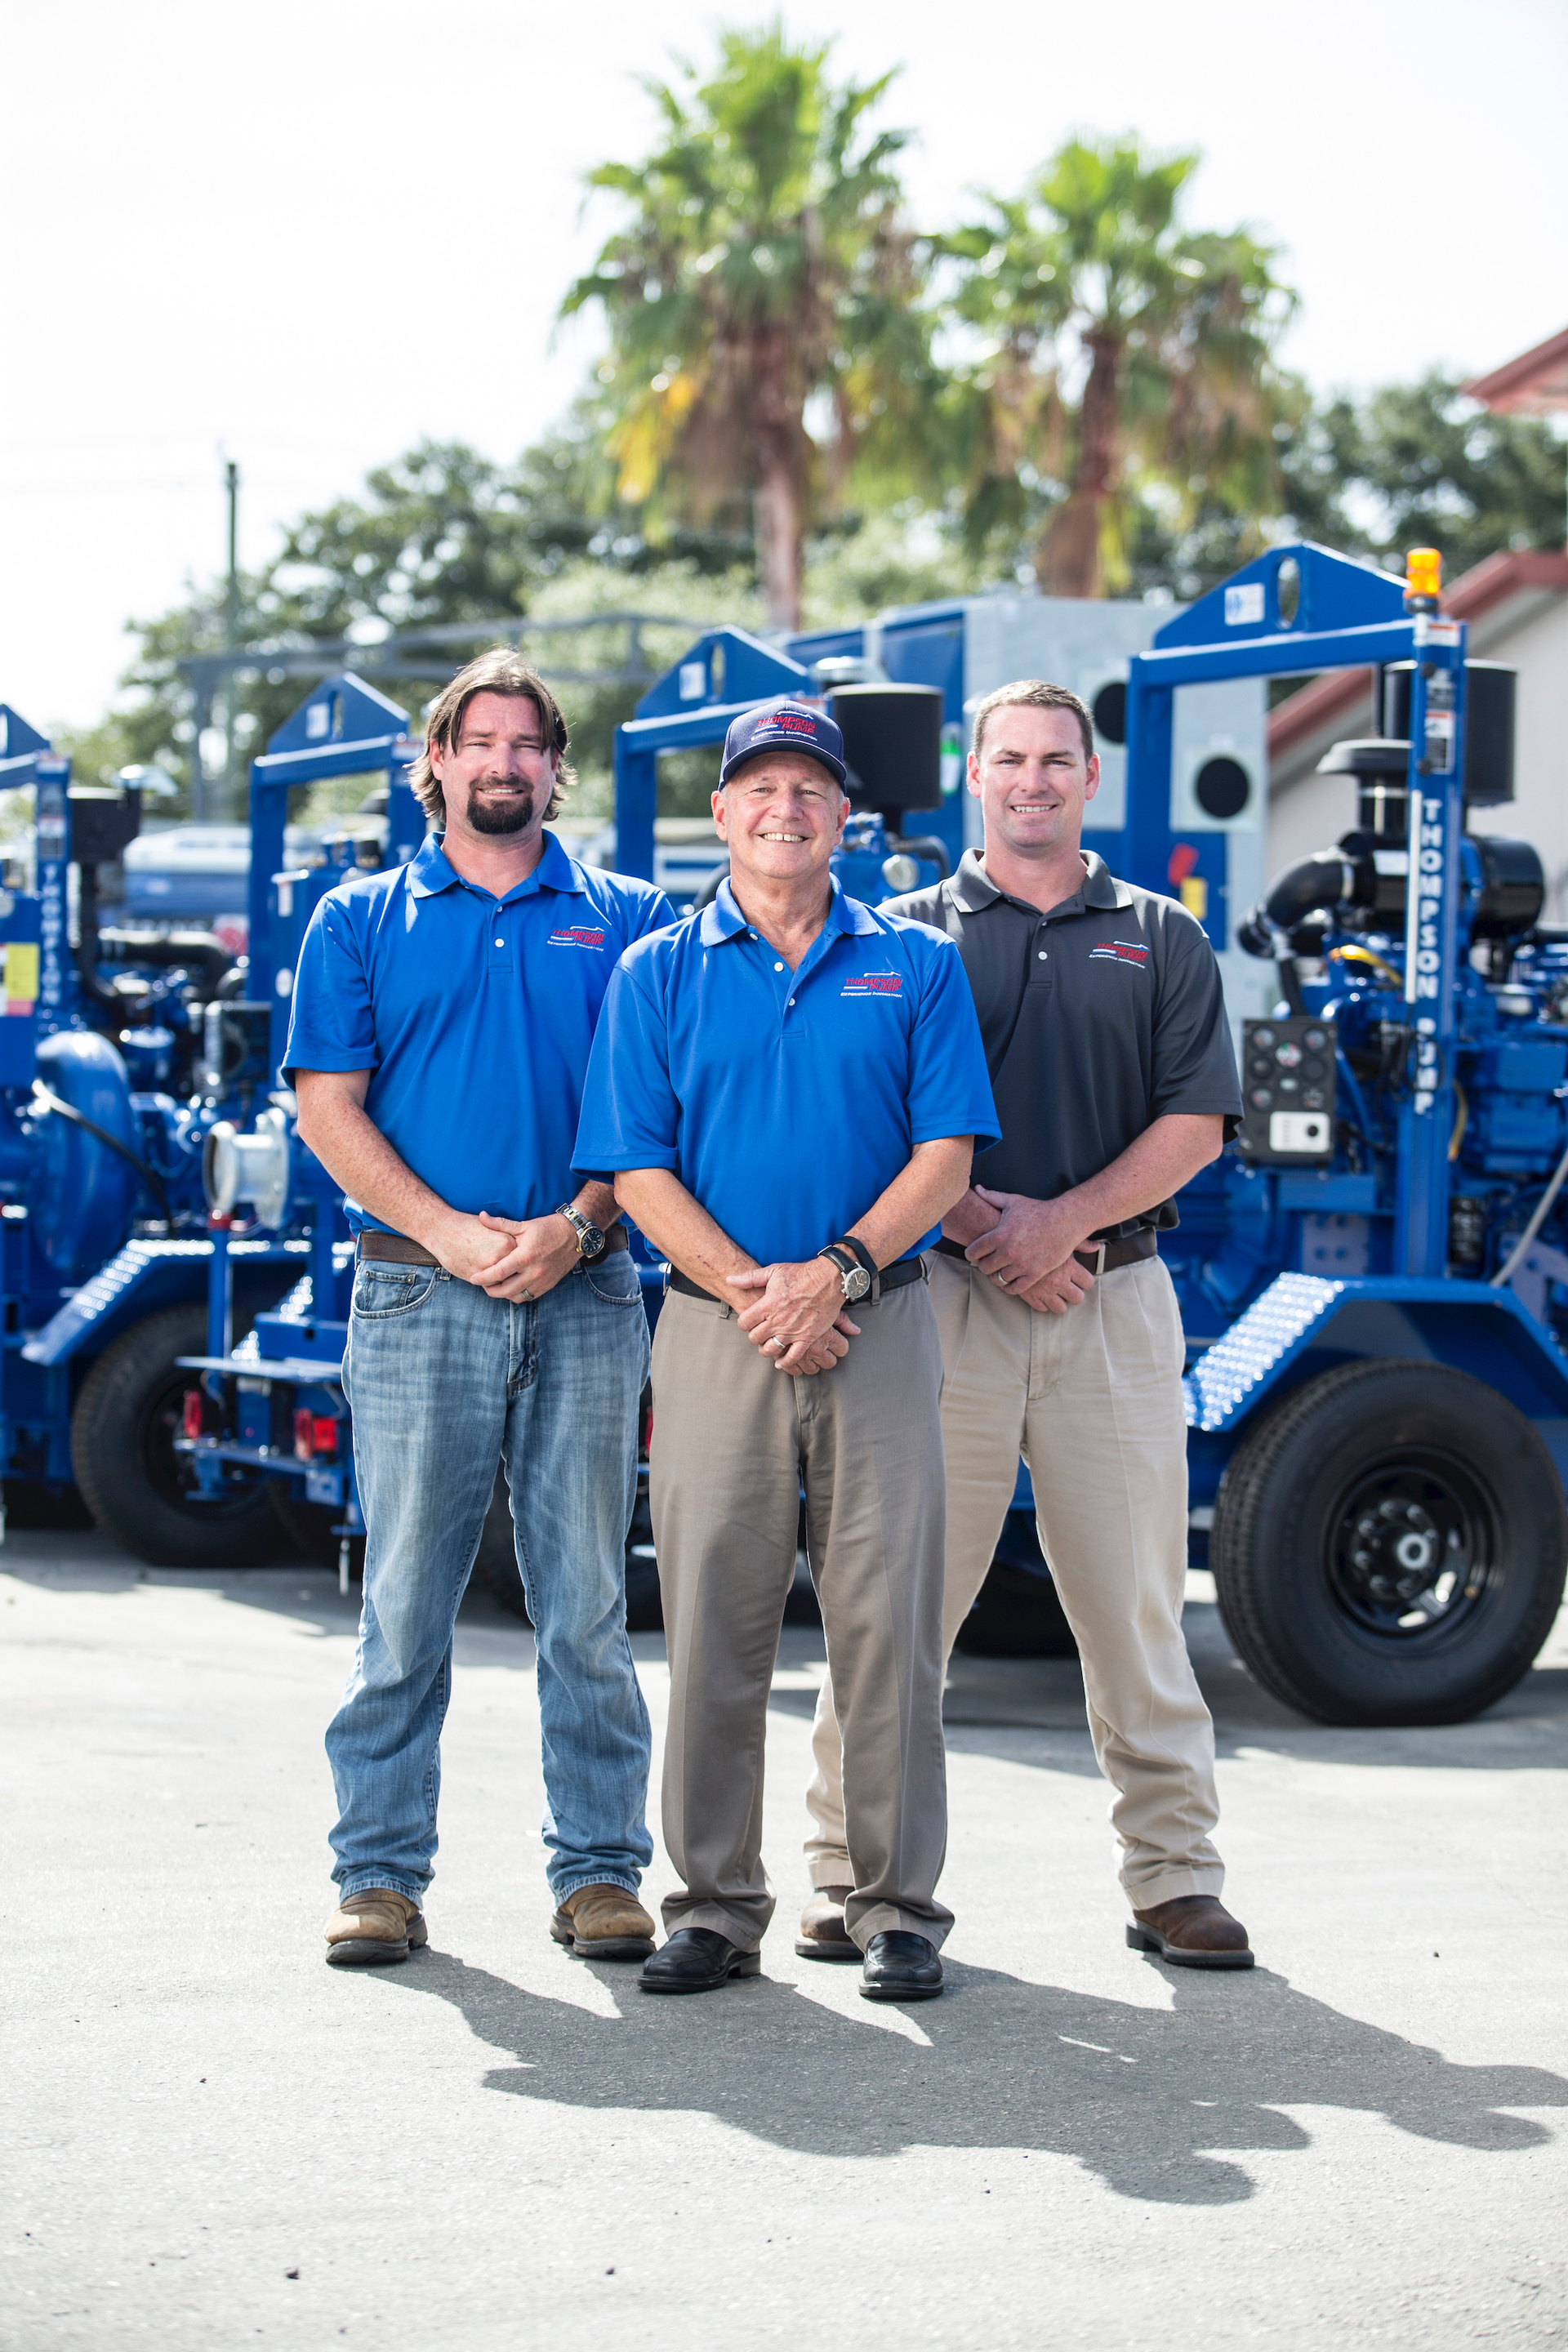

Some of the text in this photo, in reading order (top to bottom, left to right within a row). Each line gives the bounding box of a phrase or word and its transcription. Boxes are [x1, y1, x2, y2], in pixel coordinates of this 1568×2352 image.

[757, 715, 816, 729] THOMPSON
[782, 723, 815, 733] PUMP
[1415, 798, 1443, 1000] THOMPSON
[553, 929, 605, 941] THOMPSON
[574, 936, 603, 945] PUMP
[1097, 942, 1148, 958] THOMPSON
[1116, 951, 1145, 962] PUMP
[845, 978, 903, 986] THOMPSON
[869, 983, 901, 991] PUMP
